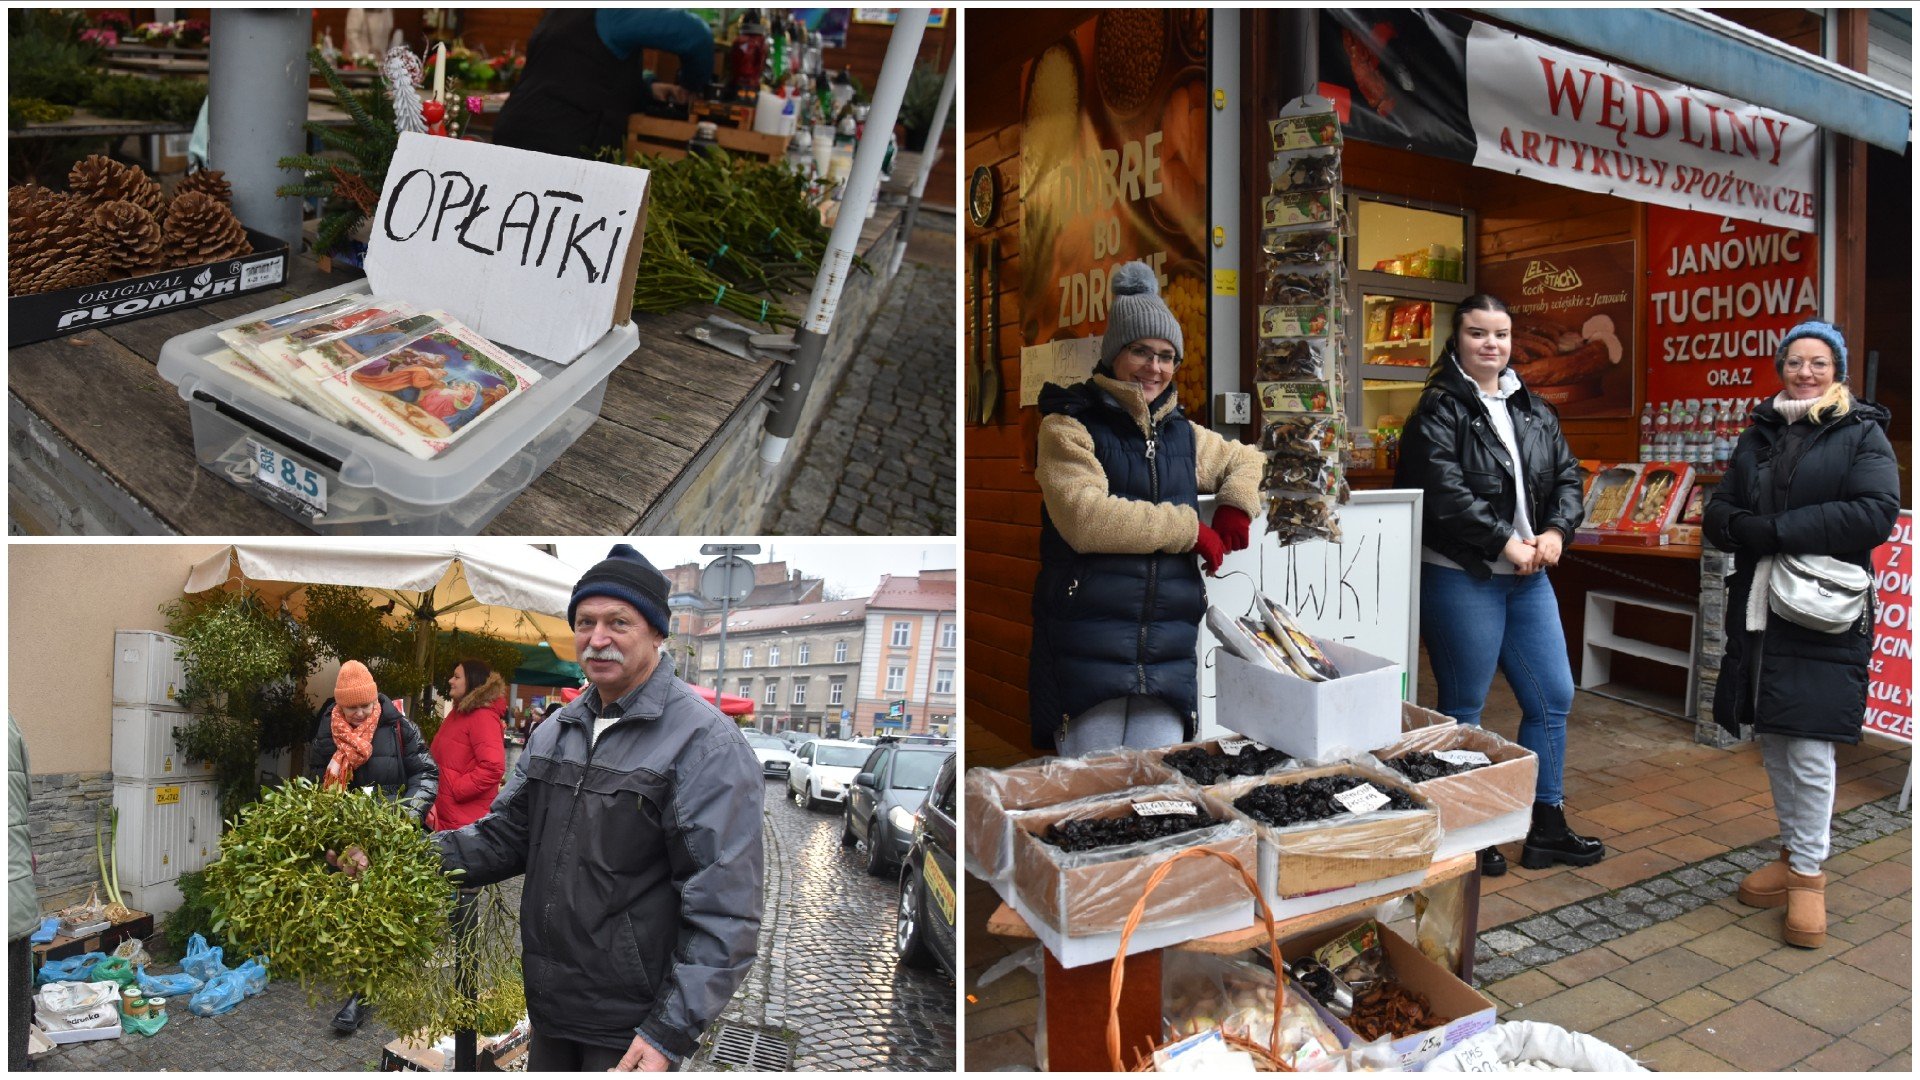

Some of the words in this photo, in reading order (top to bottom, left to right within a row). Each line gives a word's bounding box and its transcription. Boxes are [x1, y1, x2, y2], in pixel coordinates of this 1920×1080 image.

[1538, 55, 1789, 167] WĘDLINY
[1059, 130, 1164, 226] DOBRE
[1499, 126, 1669, 189] ARTYKUŁY
[1671, 163, 1816, 219] SPOŻYWCZE
[1094, 215, 1121, 260] BO
[1666, 230, 1800, 277] JANOWIC
[57, 276, 239, 329] PŁOMYK
[78, 275, 183, 305] ORIGINAL
[1650, 276, 1819, 325] TUCHOWA
[1662, 327, 1787, 363] SZCZUCIN
[1706, 367, 1753, 387] ORAZ
[280, 458, 319, 497] 8.5
[1887, 546, 1902, 567] Z
